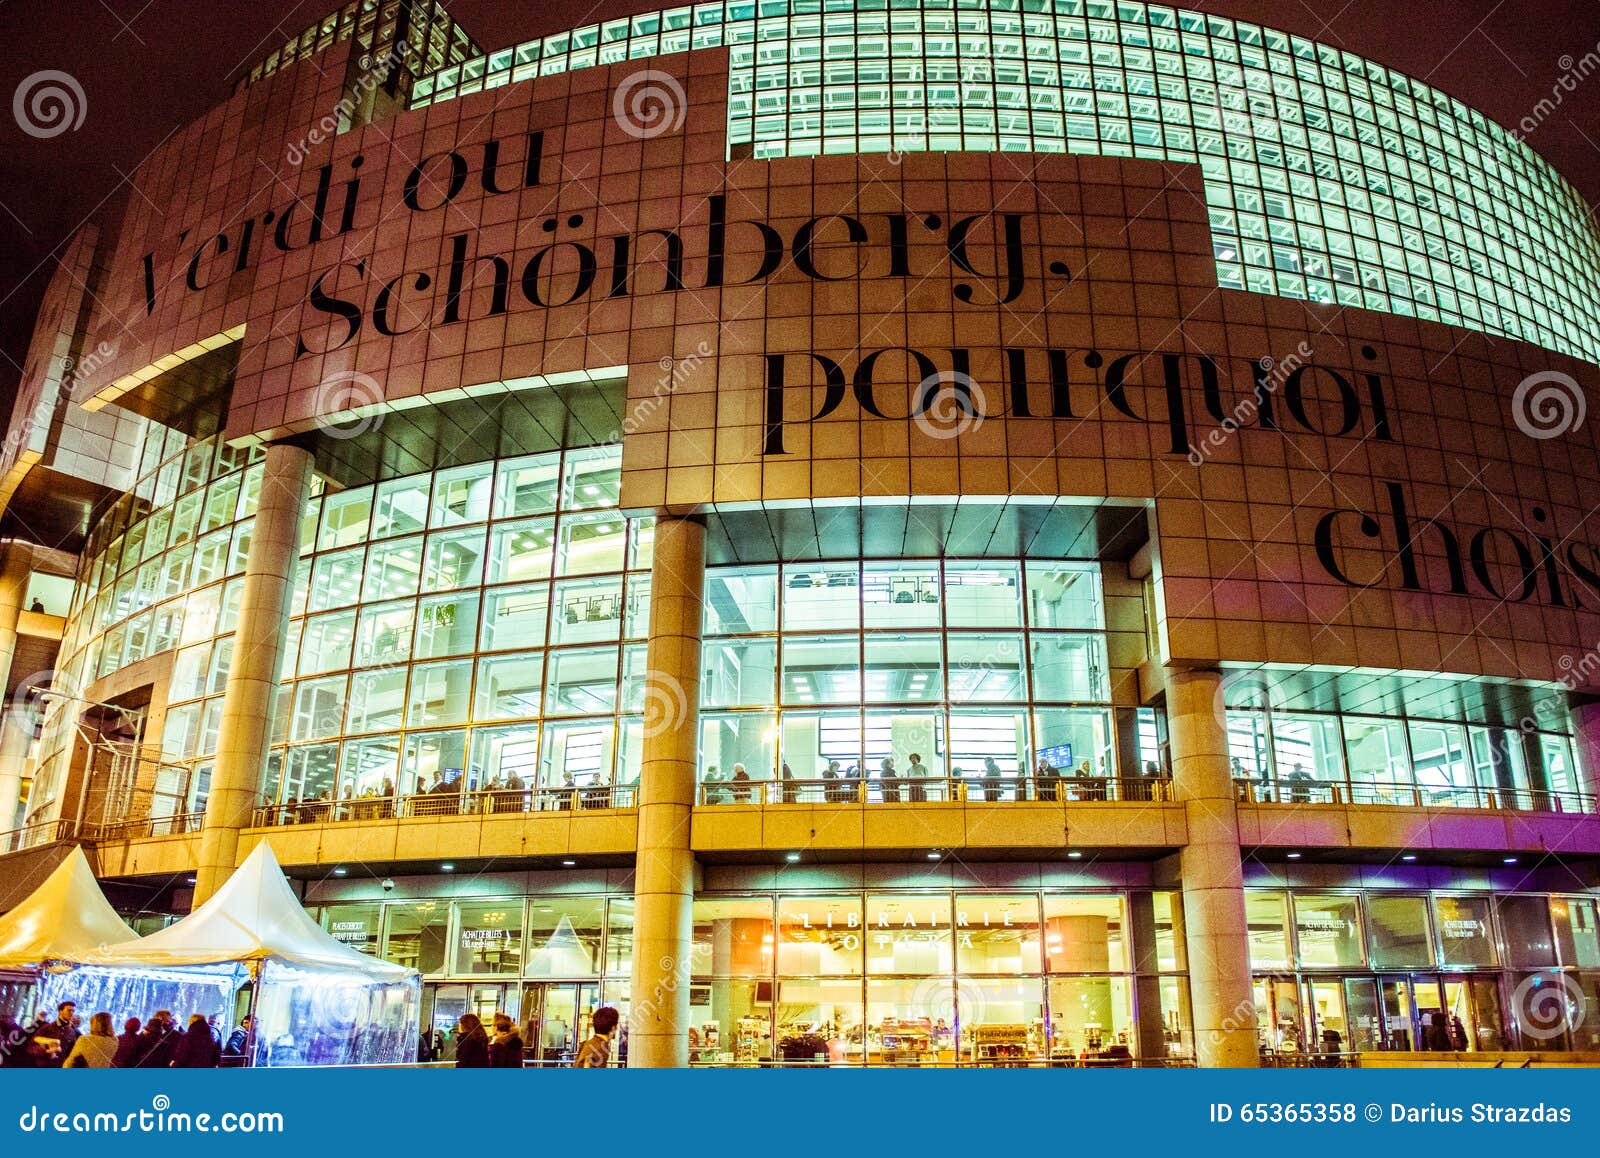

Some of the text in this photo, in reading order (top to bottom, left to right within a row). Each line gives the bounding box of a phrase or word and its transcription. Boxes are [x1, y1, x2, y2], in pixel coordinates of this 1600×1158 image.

[143, 131, 544, 316] Verdi ou
[297, 195, 1073, 362] Schönberg,
[759, 345, 1397, 455] pourquoi
[1315, 482, 1600, 612] chois
[803, 911, 1014, 929] LIBRAIRIE
